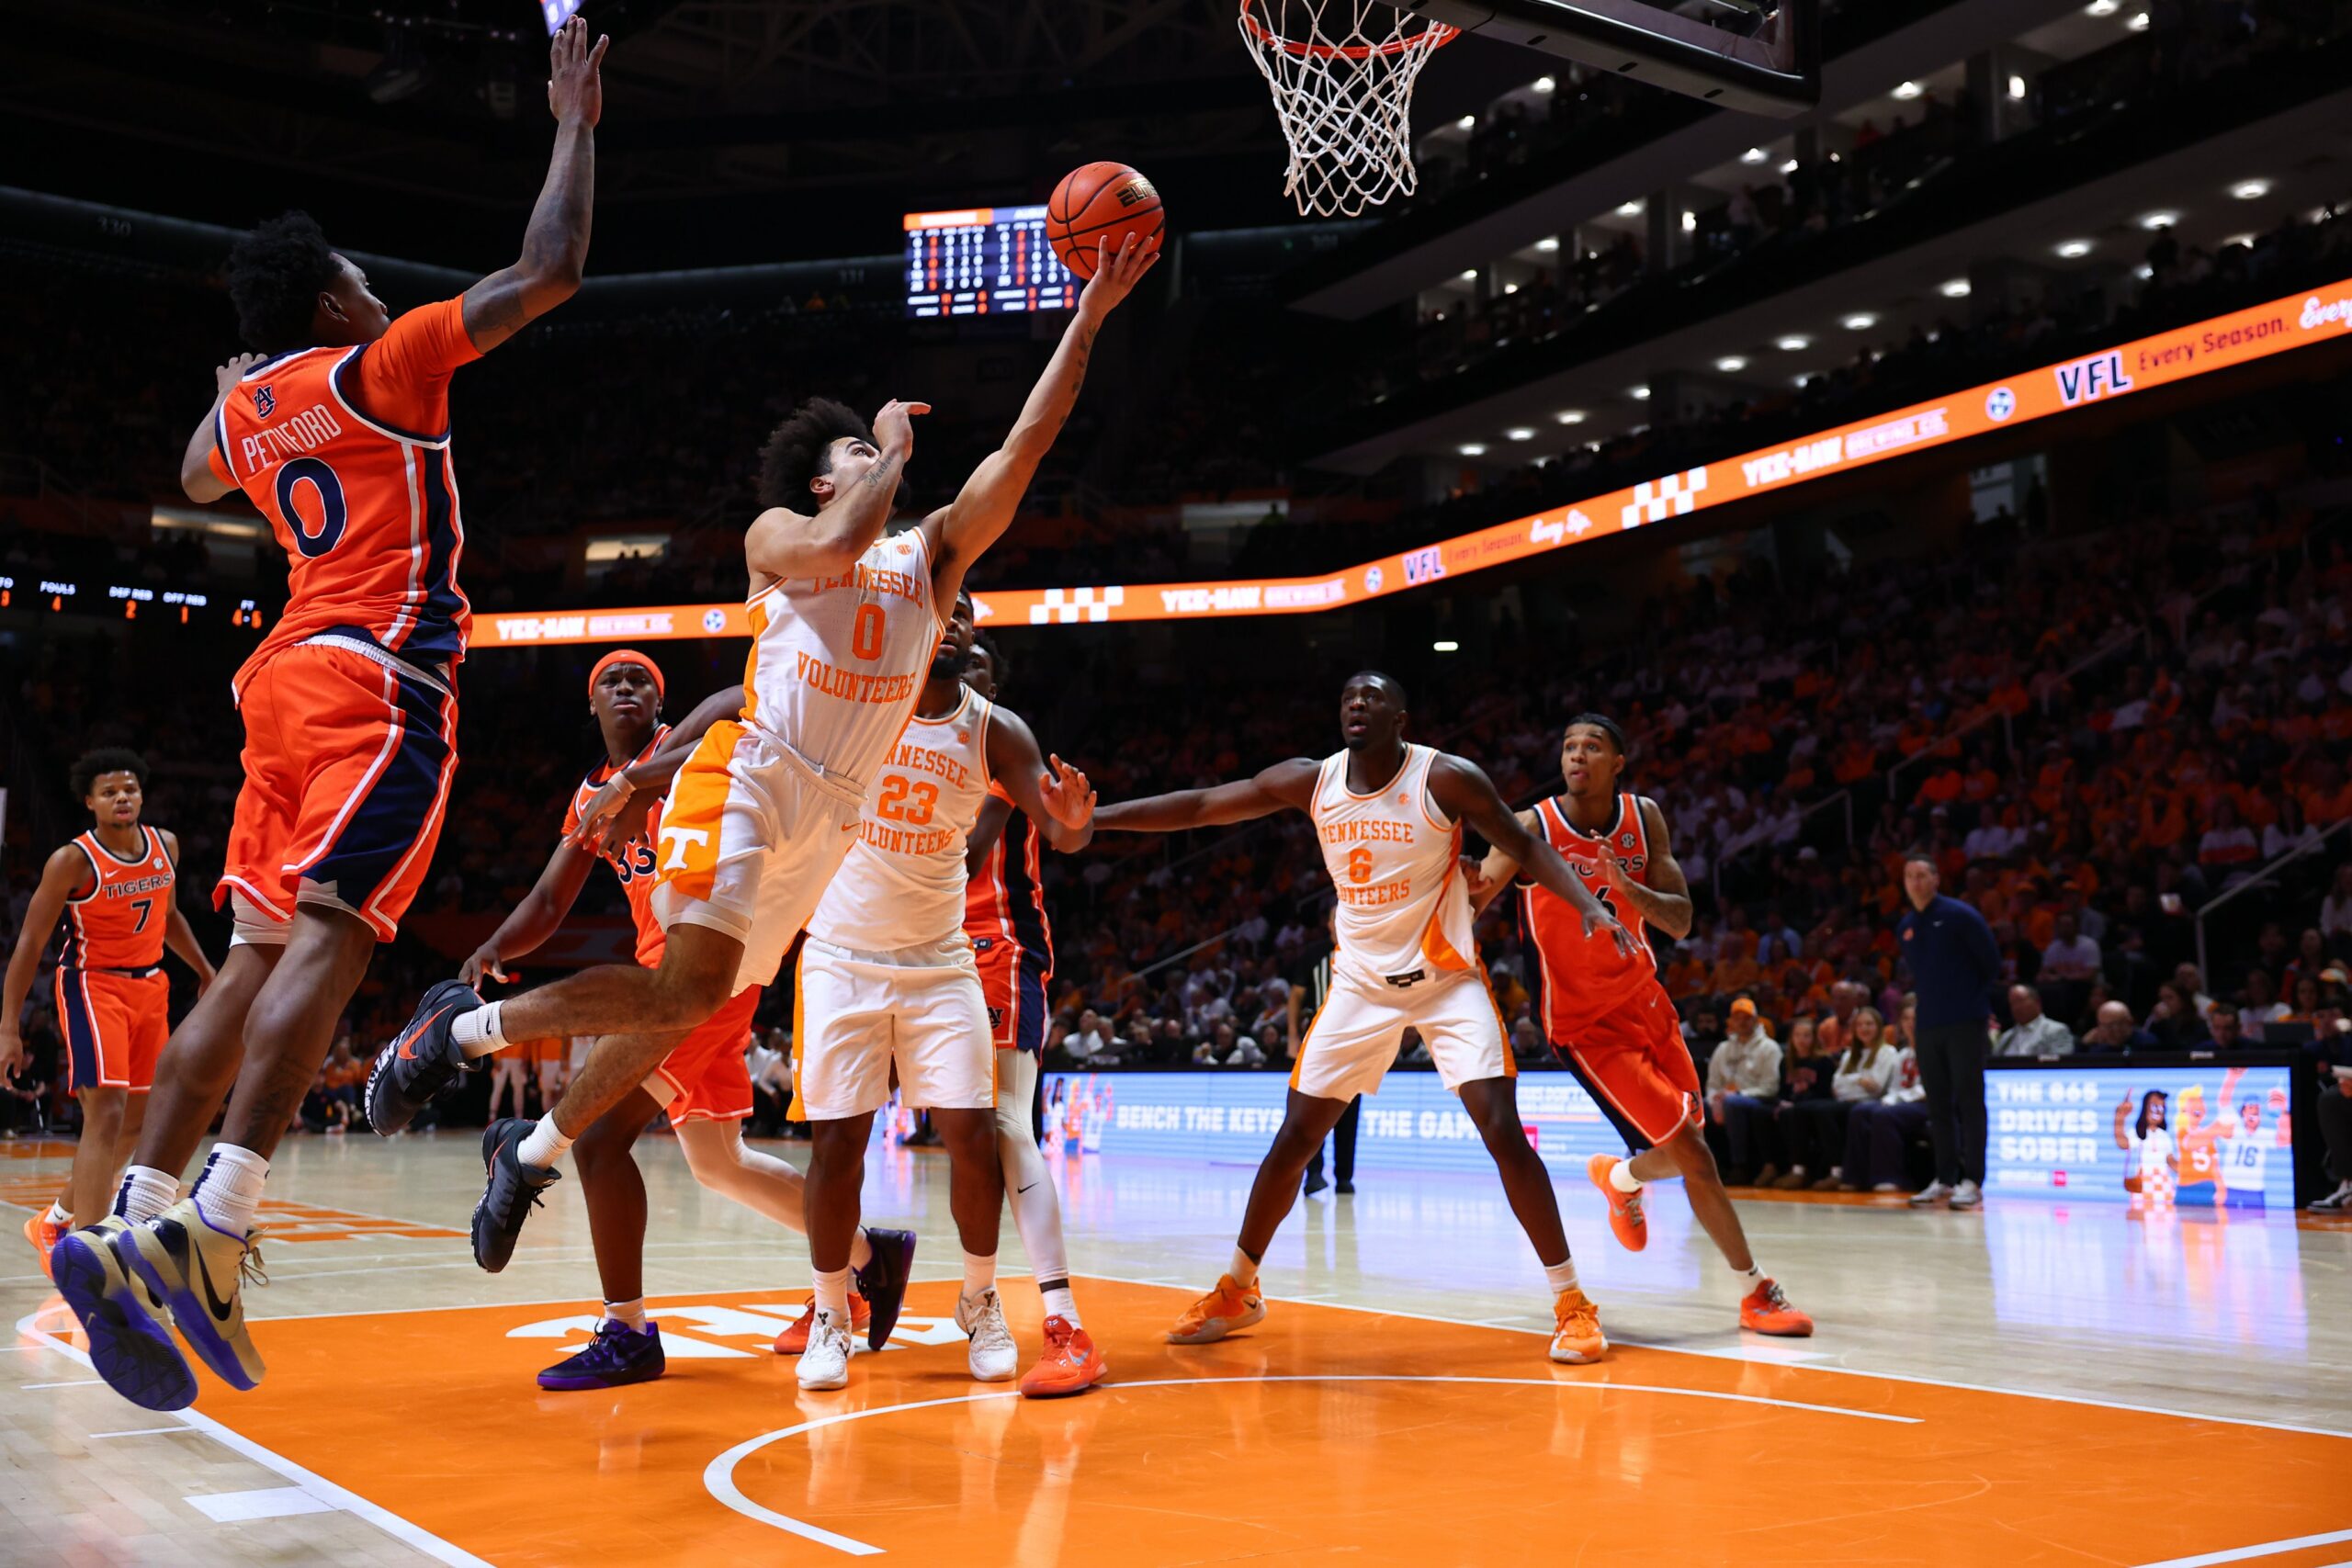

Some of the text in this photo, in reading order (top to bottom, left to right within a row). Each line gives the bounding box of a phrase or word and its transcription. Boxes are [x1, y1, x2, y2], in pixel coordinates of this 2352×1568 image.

[2055, 351, 2132, 405] VFL
[2139, 344, 2195, 371] Every
[2203, 316, 2290, 355] Season.
[1744, 437, 1841, 486] YEE-HAW
[276, 457, 347, 558] 0
[1403, 547, 1445, 585] VFL
[40, 581, 76, 595] FOULS
[1161, 587, 1261, 612] YEE-HAW
[124, 599, 138, 620] 2
[496, 616, 584, 640] YEE-HAW
[852, 603, 886, 661] 0
[797, 650, 916, 704] VOLUNTEERS
[883, 743, 968, 790] NNESSEE
[877, 774, 939, 826] 23
[858, 819, 957, 855] OLUNTEERS
[1322, 820, 1415, 843] TENNESSEE
[660, 826, 708, 872] T
[1349, 847, 1373, 884] 6
[102, 871, 173, 899] TIGERS
[130, 897, 153, 934] 7
[1996, 1082, 2042, 1102] THE
[1116, 1105, 1285, 1134] BENCH THE KEYS
[1363, 1110, 1483, 1140] THE GAM
[1998, 1110, 2098, 1133] DRIVES
[1999, 1136, 2098, 1163] SOBER
[2234, 1145, 2258, 1167] 16
